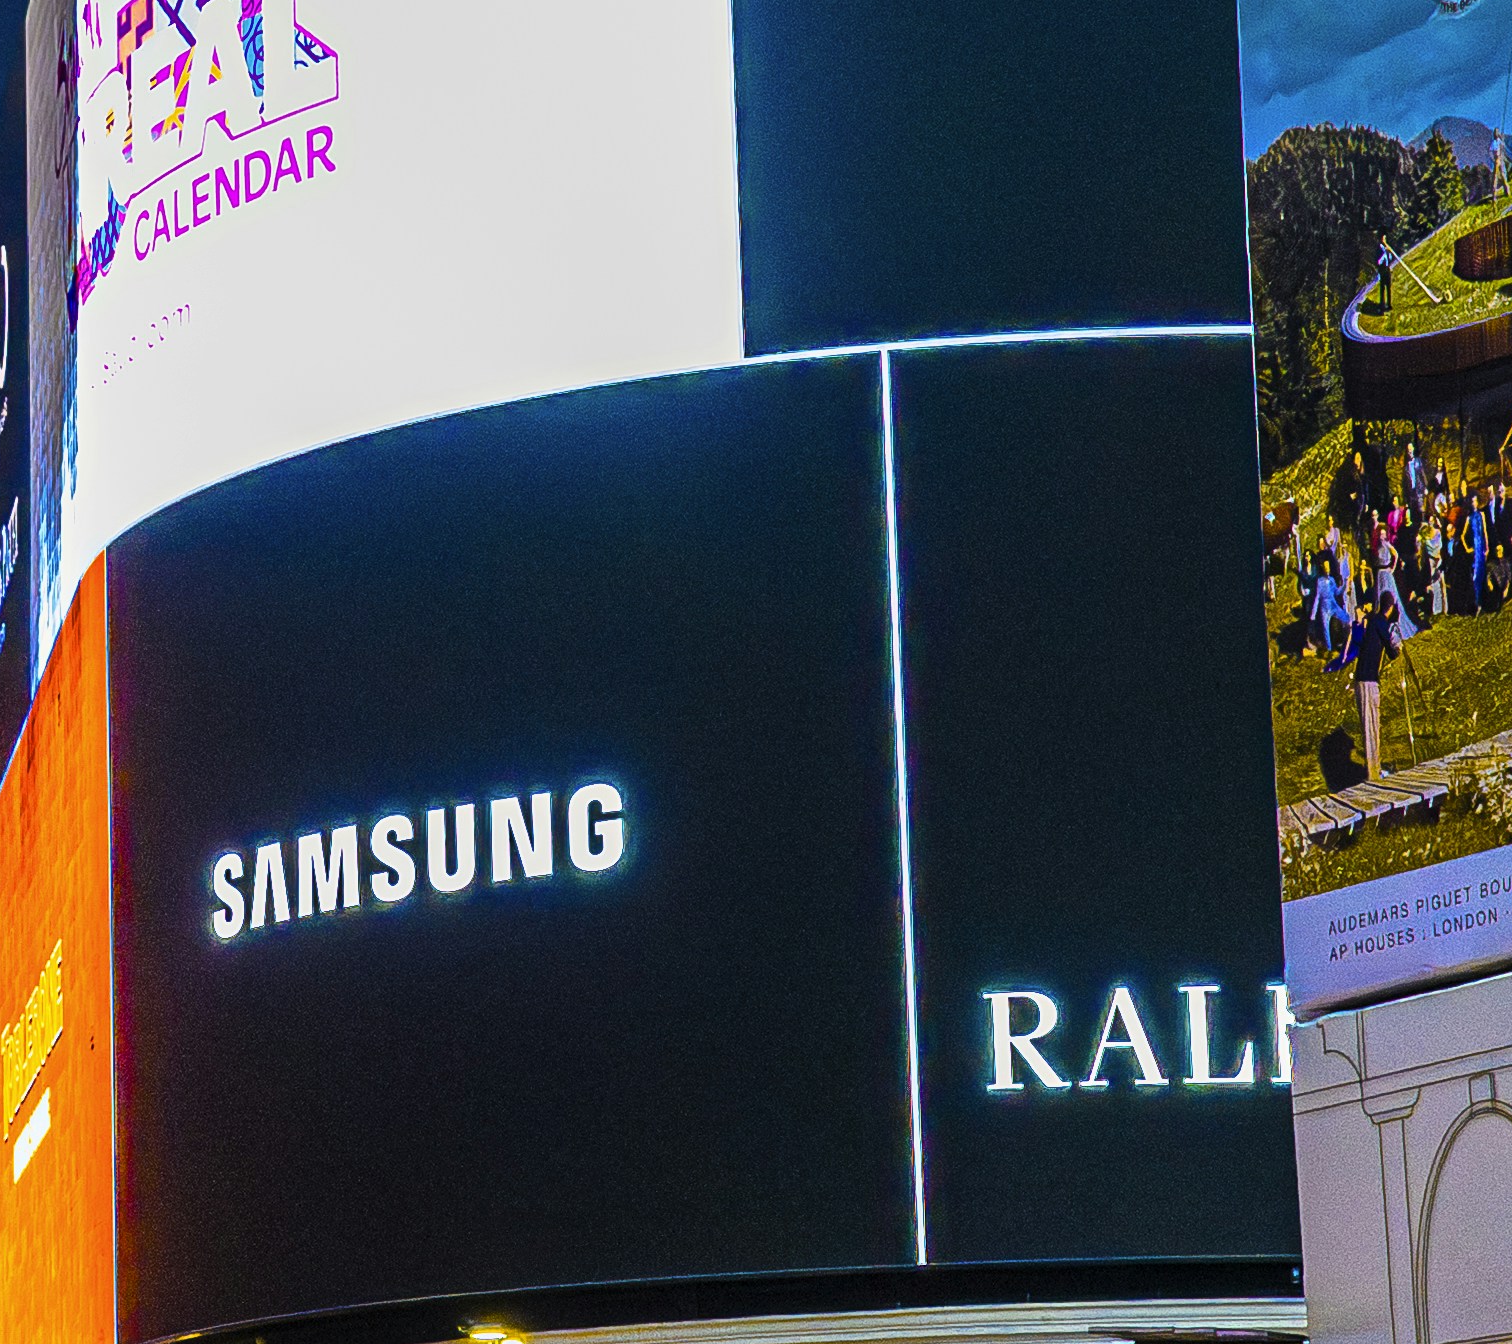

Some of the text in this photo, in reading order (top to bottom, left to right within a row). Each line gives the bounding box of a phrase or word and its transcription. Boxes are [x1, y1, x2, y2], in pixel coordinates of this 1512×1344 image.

[132, 123, 337, 261] CALENDAR
[212, 781, 626, 941] SAMSUNG
[1328, 901, 1410, 937] AUDEMARS
[1415, 886, 1473, 916] PIGUET
[1329, 940, 1349, 963] AP
[1354, 927, 1415, 956] HOUSES
[1433, 906, 1498, 938] LONDON
